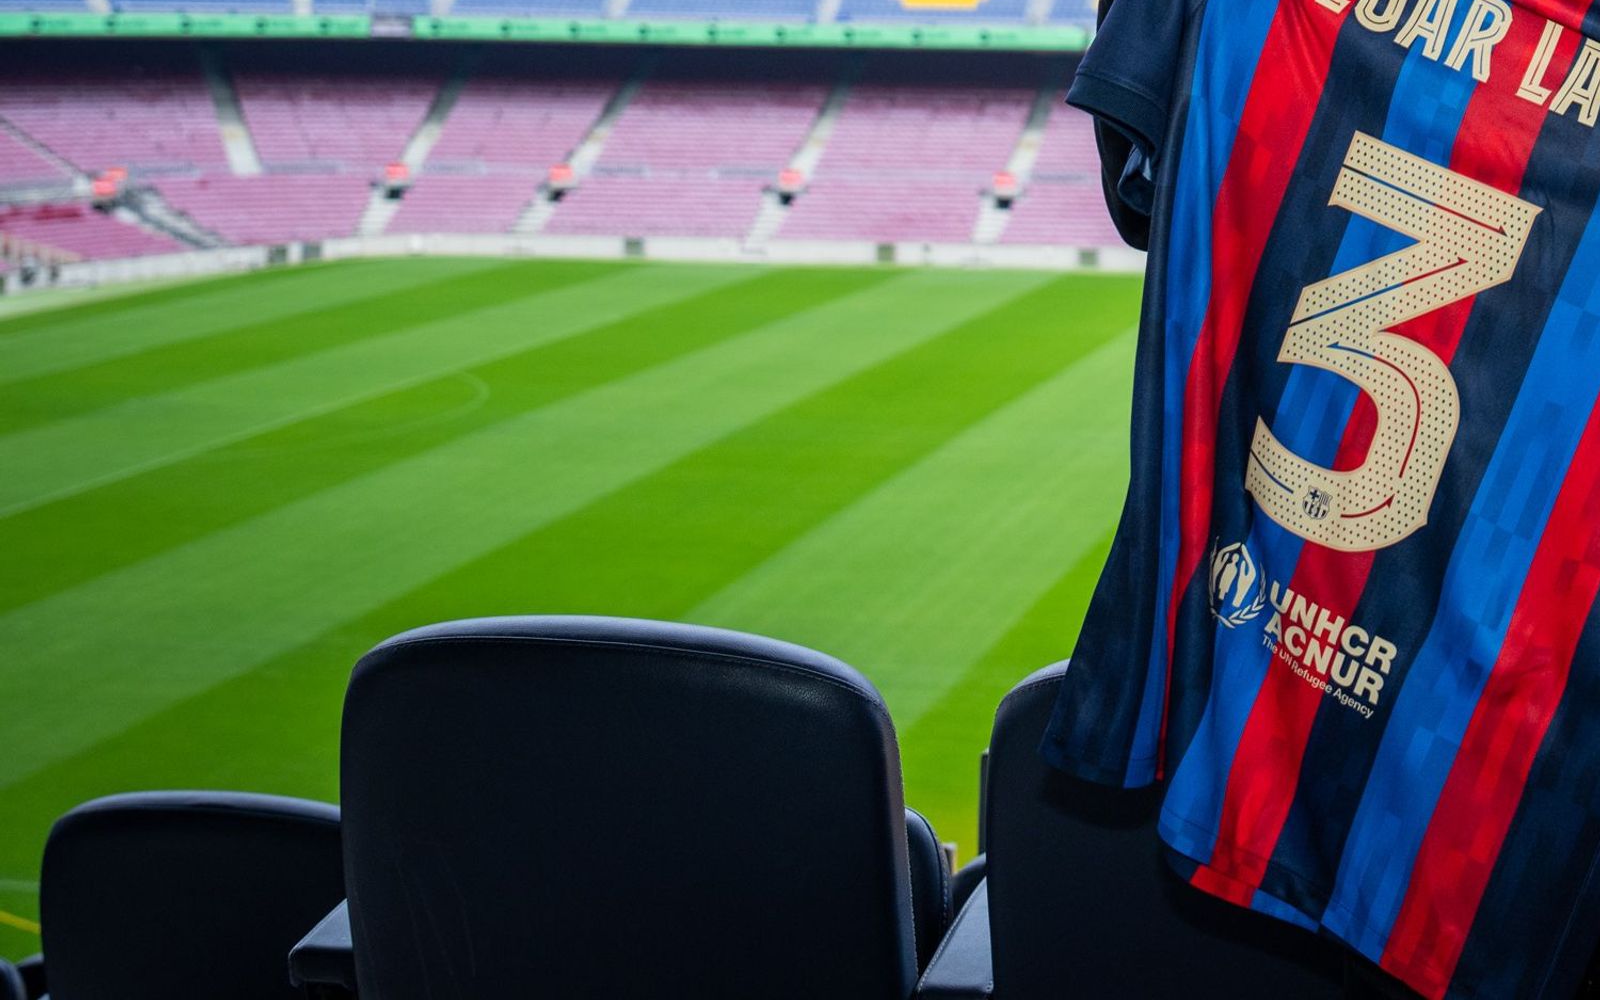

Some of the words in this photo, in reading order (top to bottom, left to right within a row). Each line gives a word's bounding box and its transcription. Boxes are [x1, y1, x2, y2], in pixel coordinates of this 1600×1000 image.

[1245, 130, 1543, 552] 3
[1264, 611, 1385, 706] ACNUR
[1270, 580, 1398, 674] UNHCR
[1262, 633, 1278, 655] The
[1279, 649, 1293, 669] UN
[1291, 662, 1333, 694] Refugee
[1333, 688, 1375, 719] Agency
